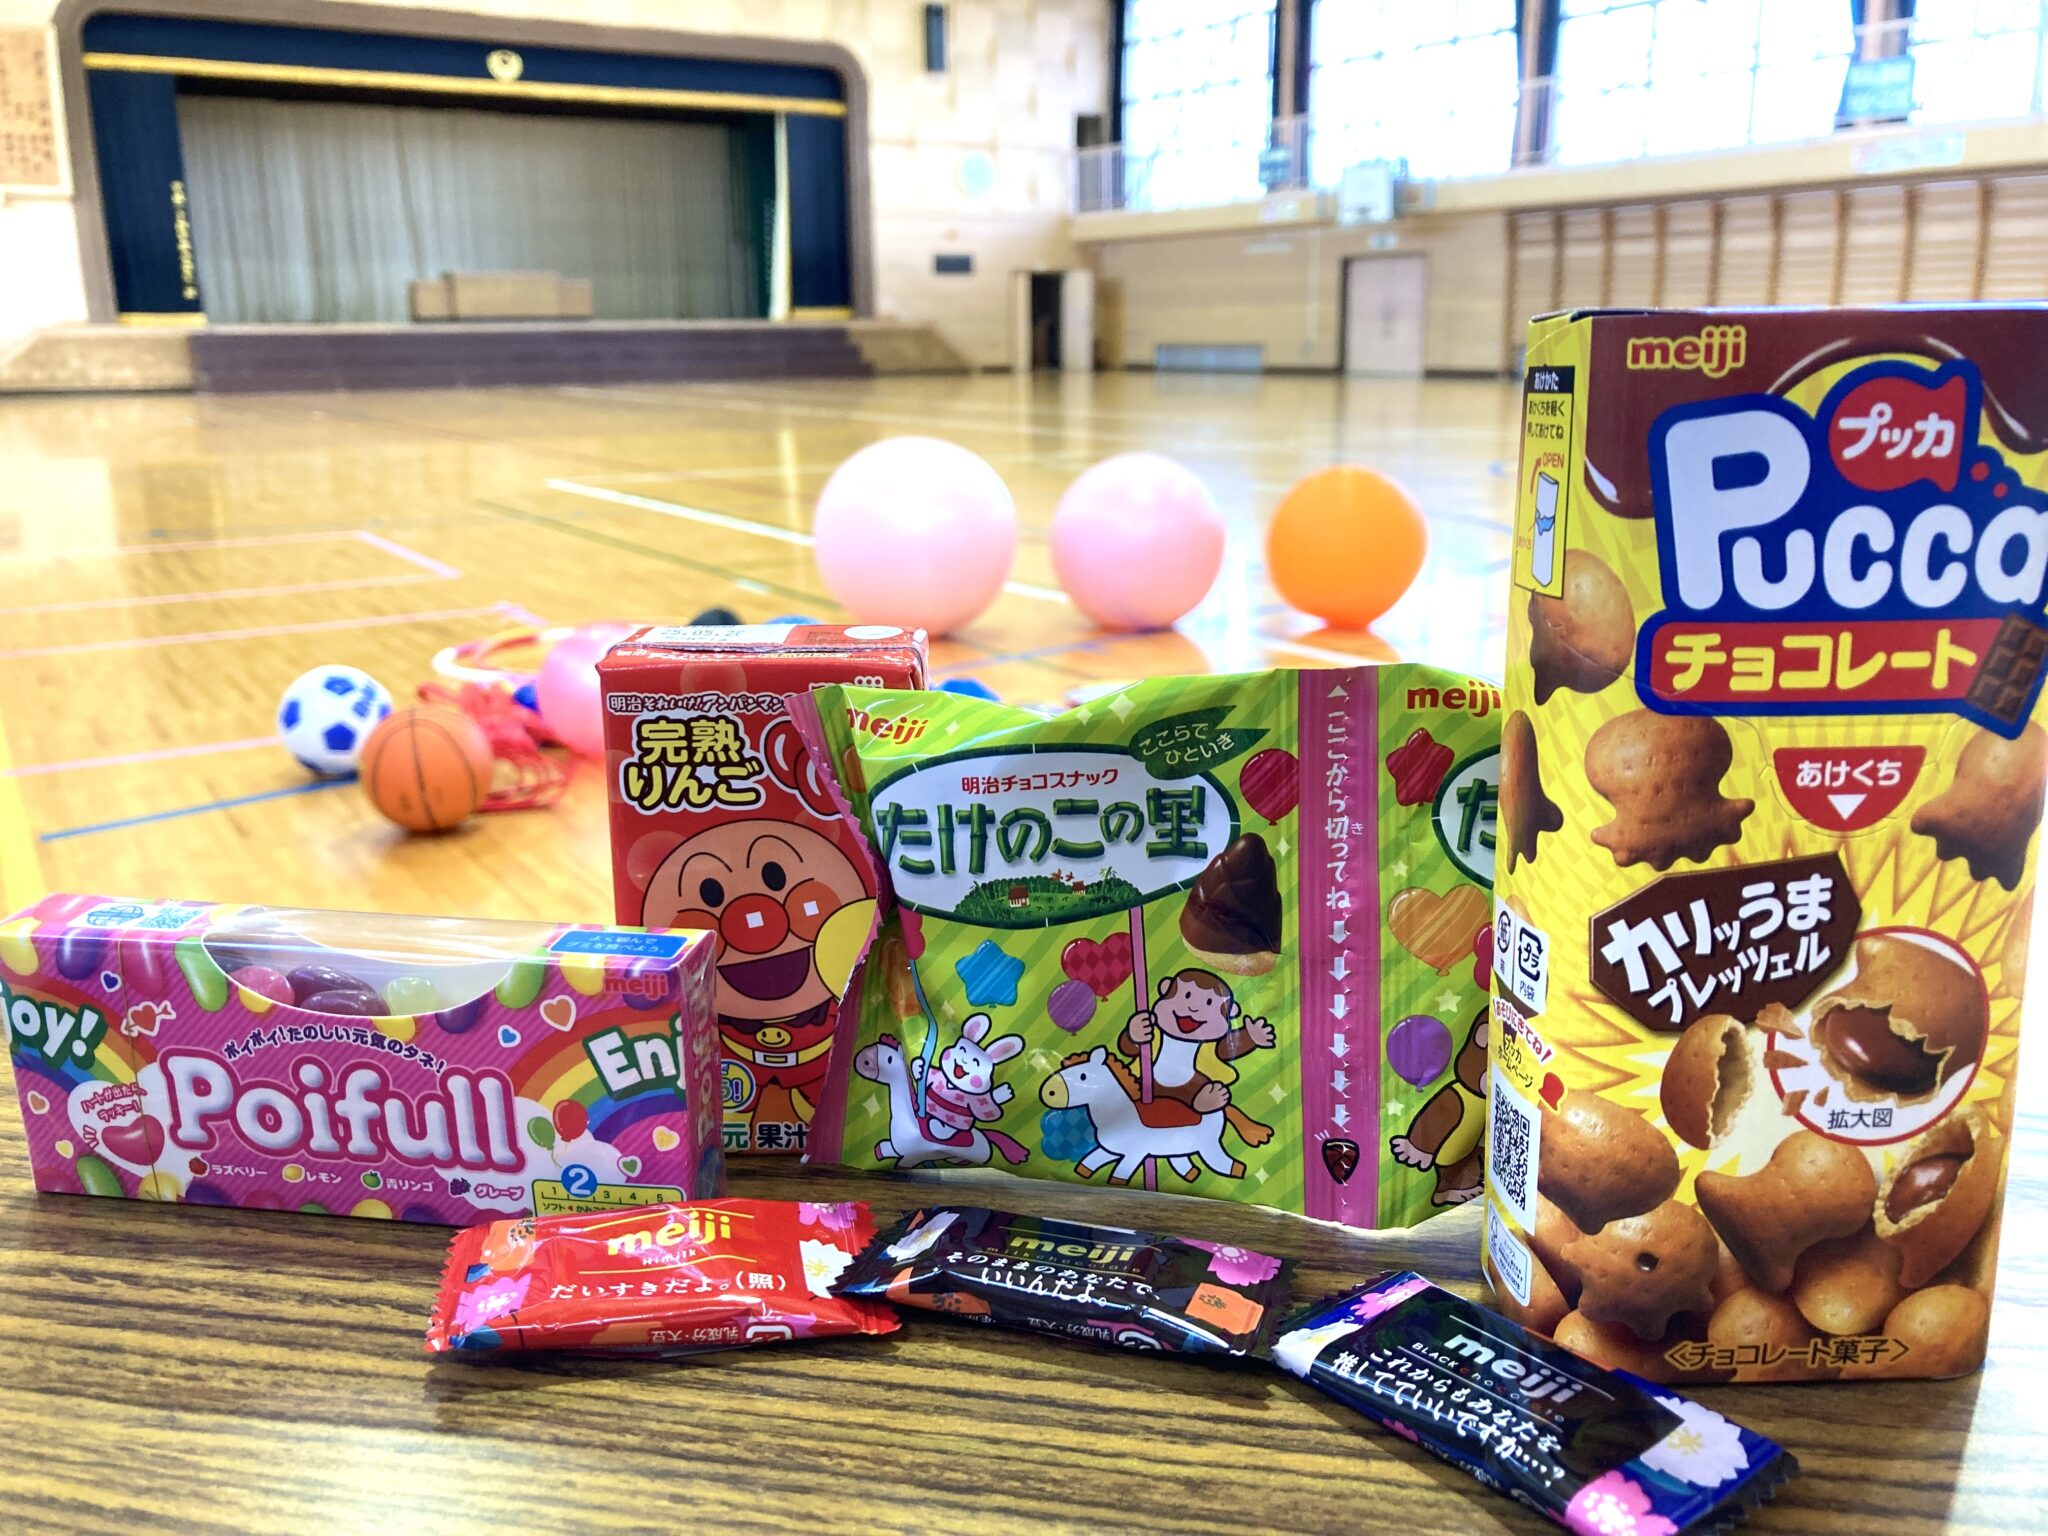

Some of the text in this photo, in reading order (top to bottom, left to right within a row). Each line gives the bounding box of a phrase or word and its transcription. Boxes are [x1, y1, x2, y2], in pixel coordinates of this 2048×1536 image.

[1628, 325, 1746, 377] meiji
[1534, 371, 1559, 391] あけかた
[1838, 402, 1954, 460] プッカ
[1542, 452, 1564, 468] OPEN
[1665, 409, 2048, 611] Pucca
[1665, 628, 1977, 691] チョコレート
[640, 718, 742, 764] 完熟
[1138, 723, 1208, 755] ここらで
[1164, 733, 1234, 764] ひといき
[627, 760, 761, 808] りんご
[961, 768, 1119, 795] 明治チョコスナック
[1796, 760, 1902, 787] あけくち
[1326, 711, 1350, 909] ここから切ってね
[875, 785, 1209, 875] たけのこの里
[1600, 873, 1834, 993] カリッうま
[605, 972, 669, 1000] meiji
[1648, 932, 1832, 1024] プレッツェル
[165, 1053, 520, 1168] Poifull
[1827, 1107, 1892, 1129] 拡大図
[757, 1123, 809, 1149] 果汁
[211, 1164, 268, 1178] ラズベリー
[305, 1171, 342, 1185] レモン
[385, 1178, 434, 1193] 青リンゴ
[551, 1168, 664, 1203] 1 2 3 4 5
[543, 1202, 566, 1211] ソフト
[607, 1210, 732, 1256] meiji
[1009, 1236, 1137, 1264] meiji
[946, 1251, 1161, 1301] そのままのあなたで、
[981, 1267, 1108, 1307] いいんだよ。
[1411, 1341, 1459, 1370] BLACK
[1443, 1333, 1584, 1404] meiji
[1369, 1348, 1563, 1453] これからもあなたを
